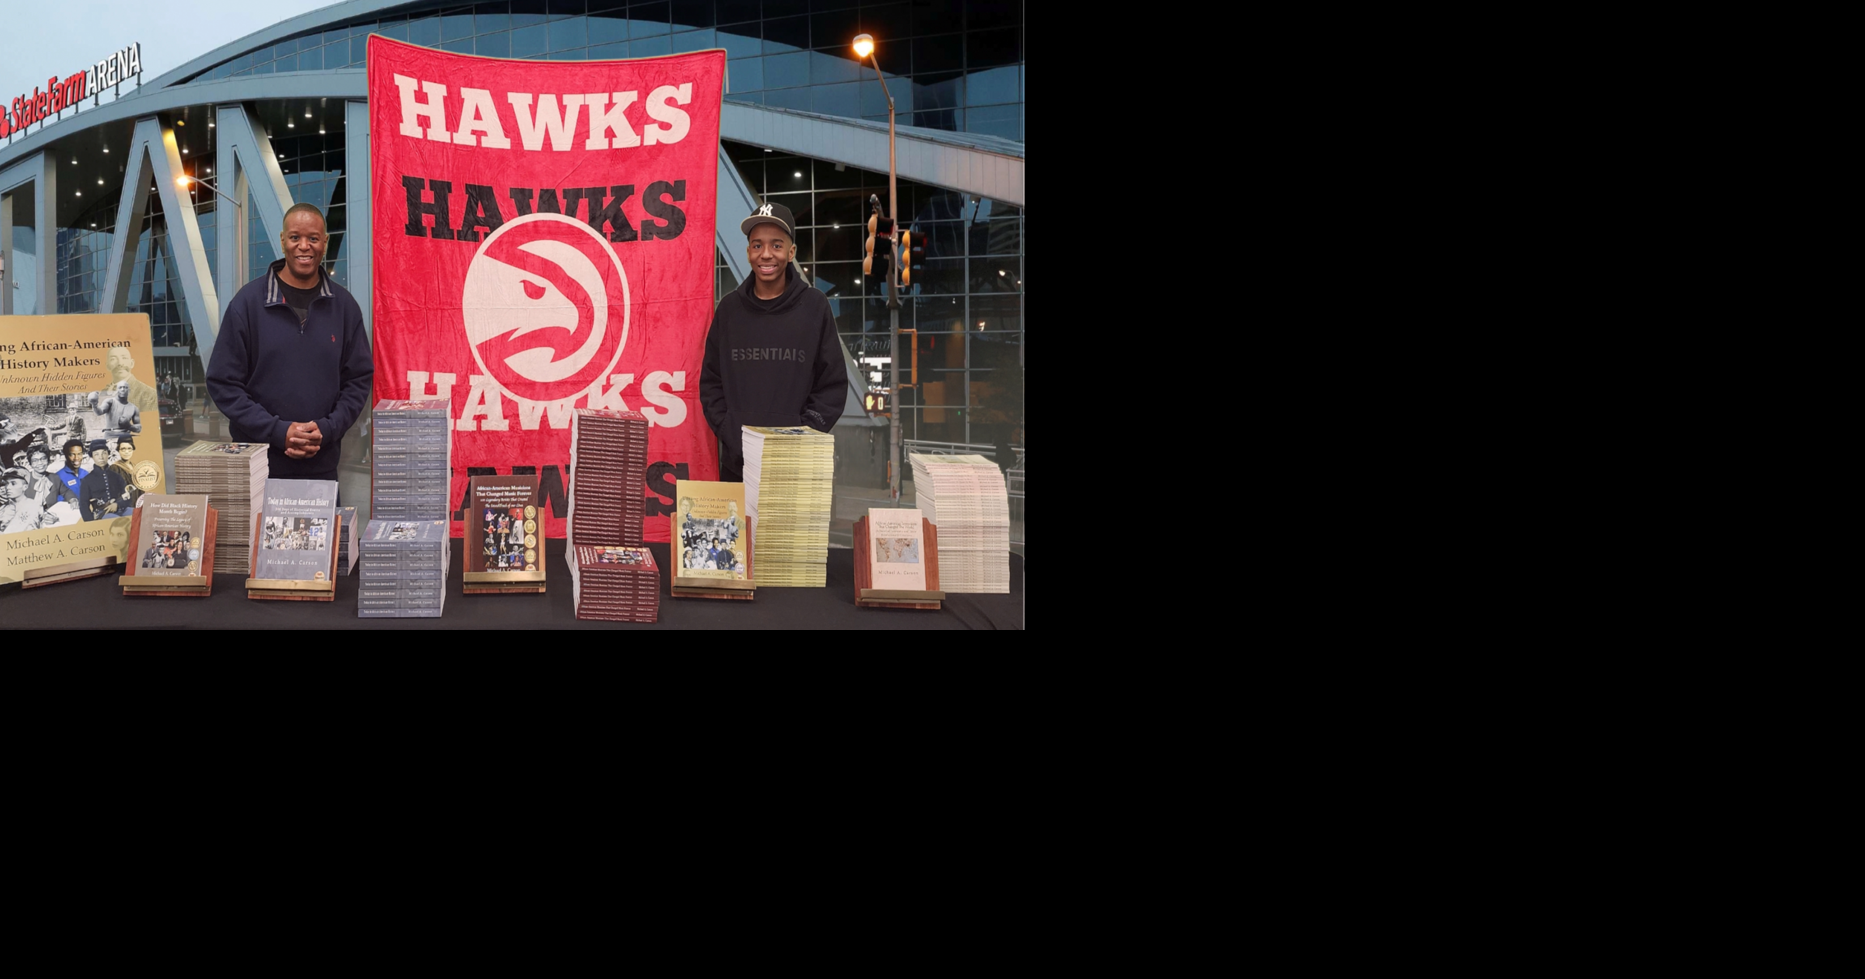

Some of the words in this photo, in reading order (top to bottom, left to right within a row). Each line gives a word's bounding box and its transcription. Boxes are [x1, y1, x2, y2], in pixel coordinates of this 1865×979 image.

[88, 42, 141, 97] ARENA
[393, 73, 692, 151] HAWKS
[20, 338, 131, 351] African-American
[1, 359, 50, 371] History
[54, 356, 100, 368] Makers
[41, 372, 74, 382] Hidden
[75, 371, 106, 382] Figures
[18, 386, 36, 394] And
[38, 384, 60, 392] Their
[61, 383, 88, 392] Stories
[6, 535, 50, 550] Michael
[53, 534, 64, 544] A.
[68, 529, 104, 540] Carson
[7, 552, 54, 566] Matthew
[56, 550, 67, 558] A.
[70, 544, 106, 556] Carson
